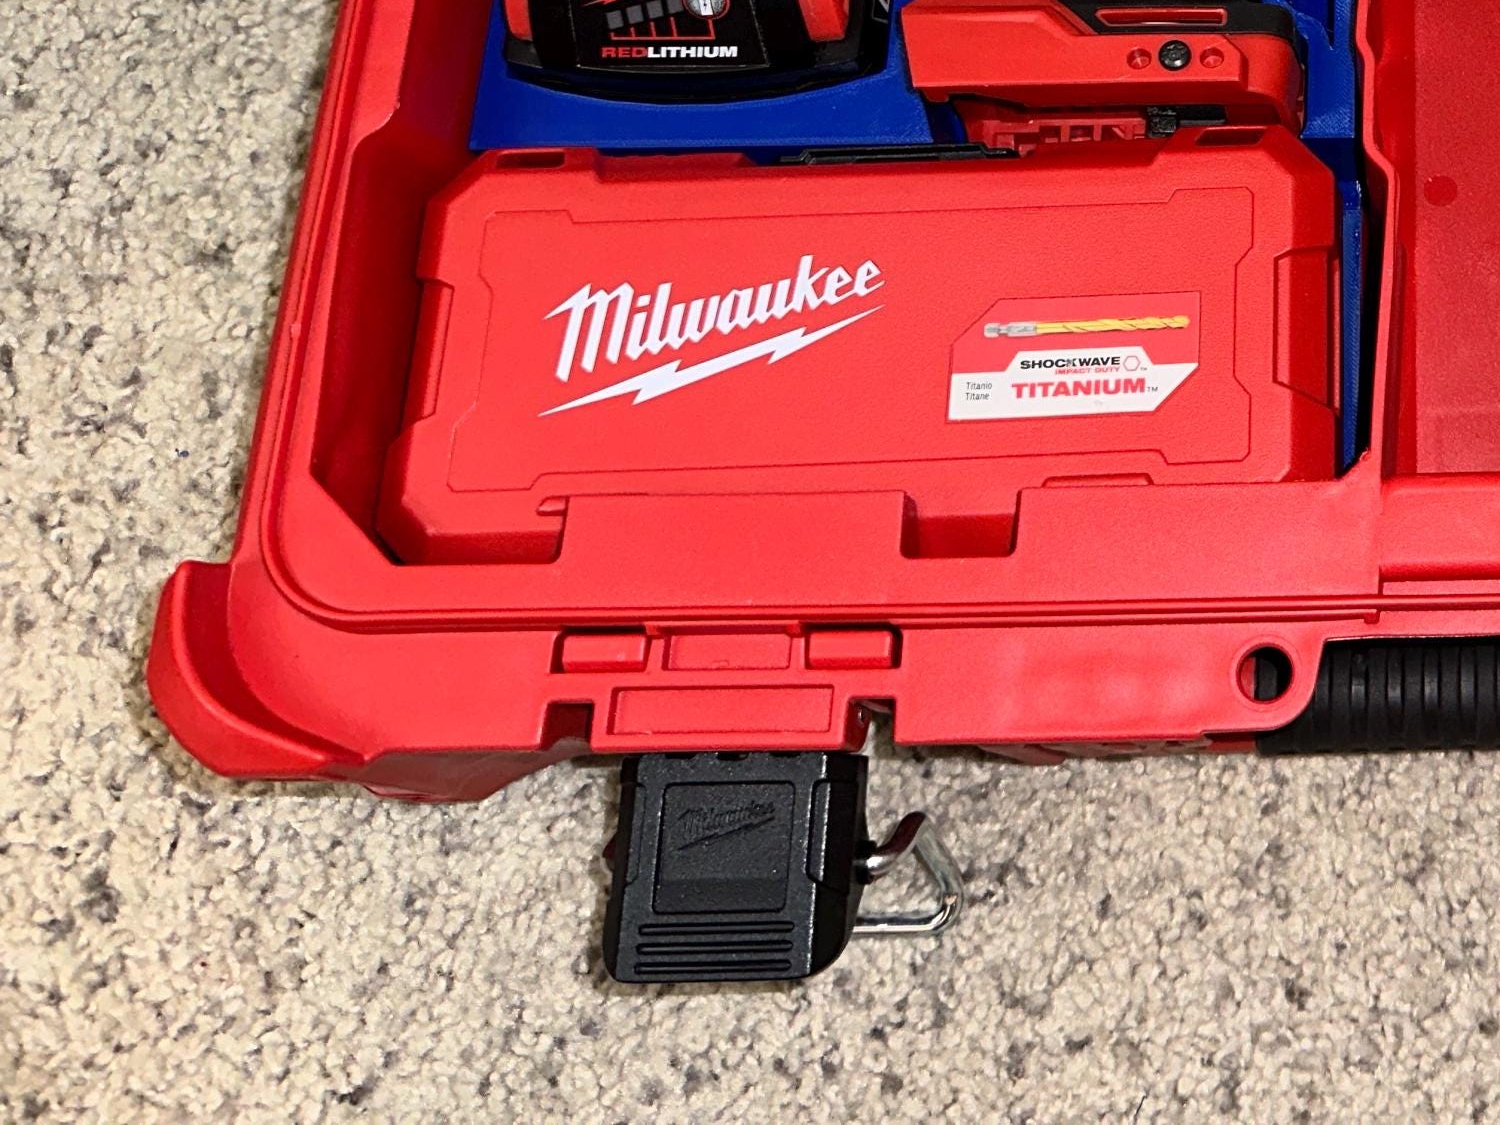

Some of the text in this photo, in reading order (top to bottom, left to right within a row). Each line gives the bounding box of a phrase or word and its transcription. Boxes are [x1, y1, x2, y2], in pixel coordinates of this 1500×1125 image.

[601, 45, 738, 60] REDLITHIUM
[541, 254, 887, 382] Milwaukee
[1020, 356, 1121, 370] SHOCKWAVE
[1055, 366, 1121, 375] IMPACT DUTY
[965, 381, 992, 390] Titanio
[965, 392, 989, 401] Titane
